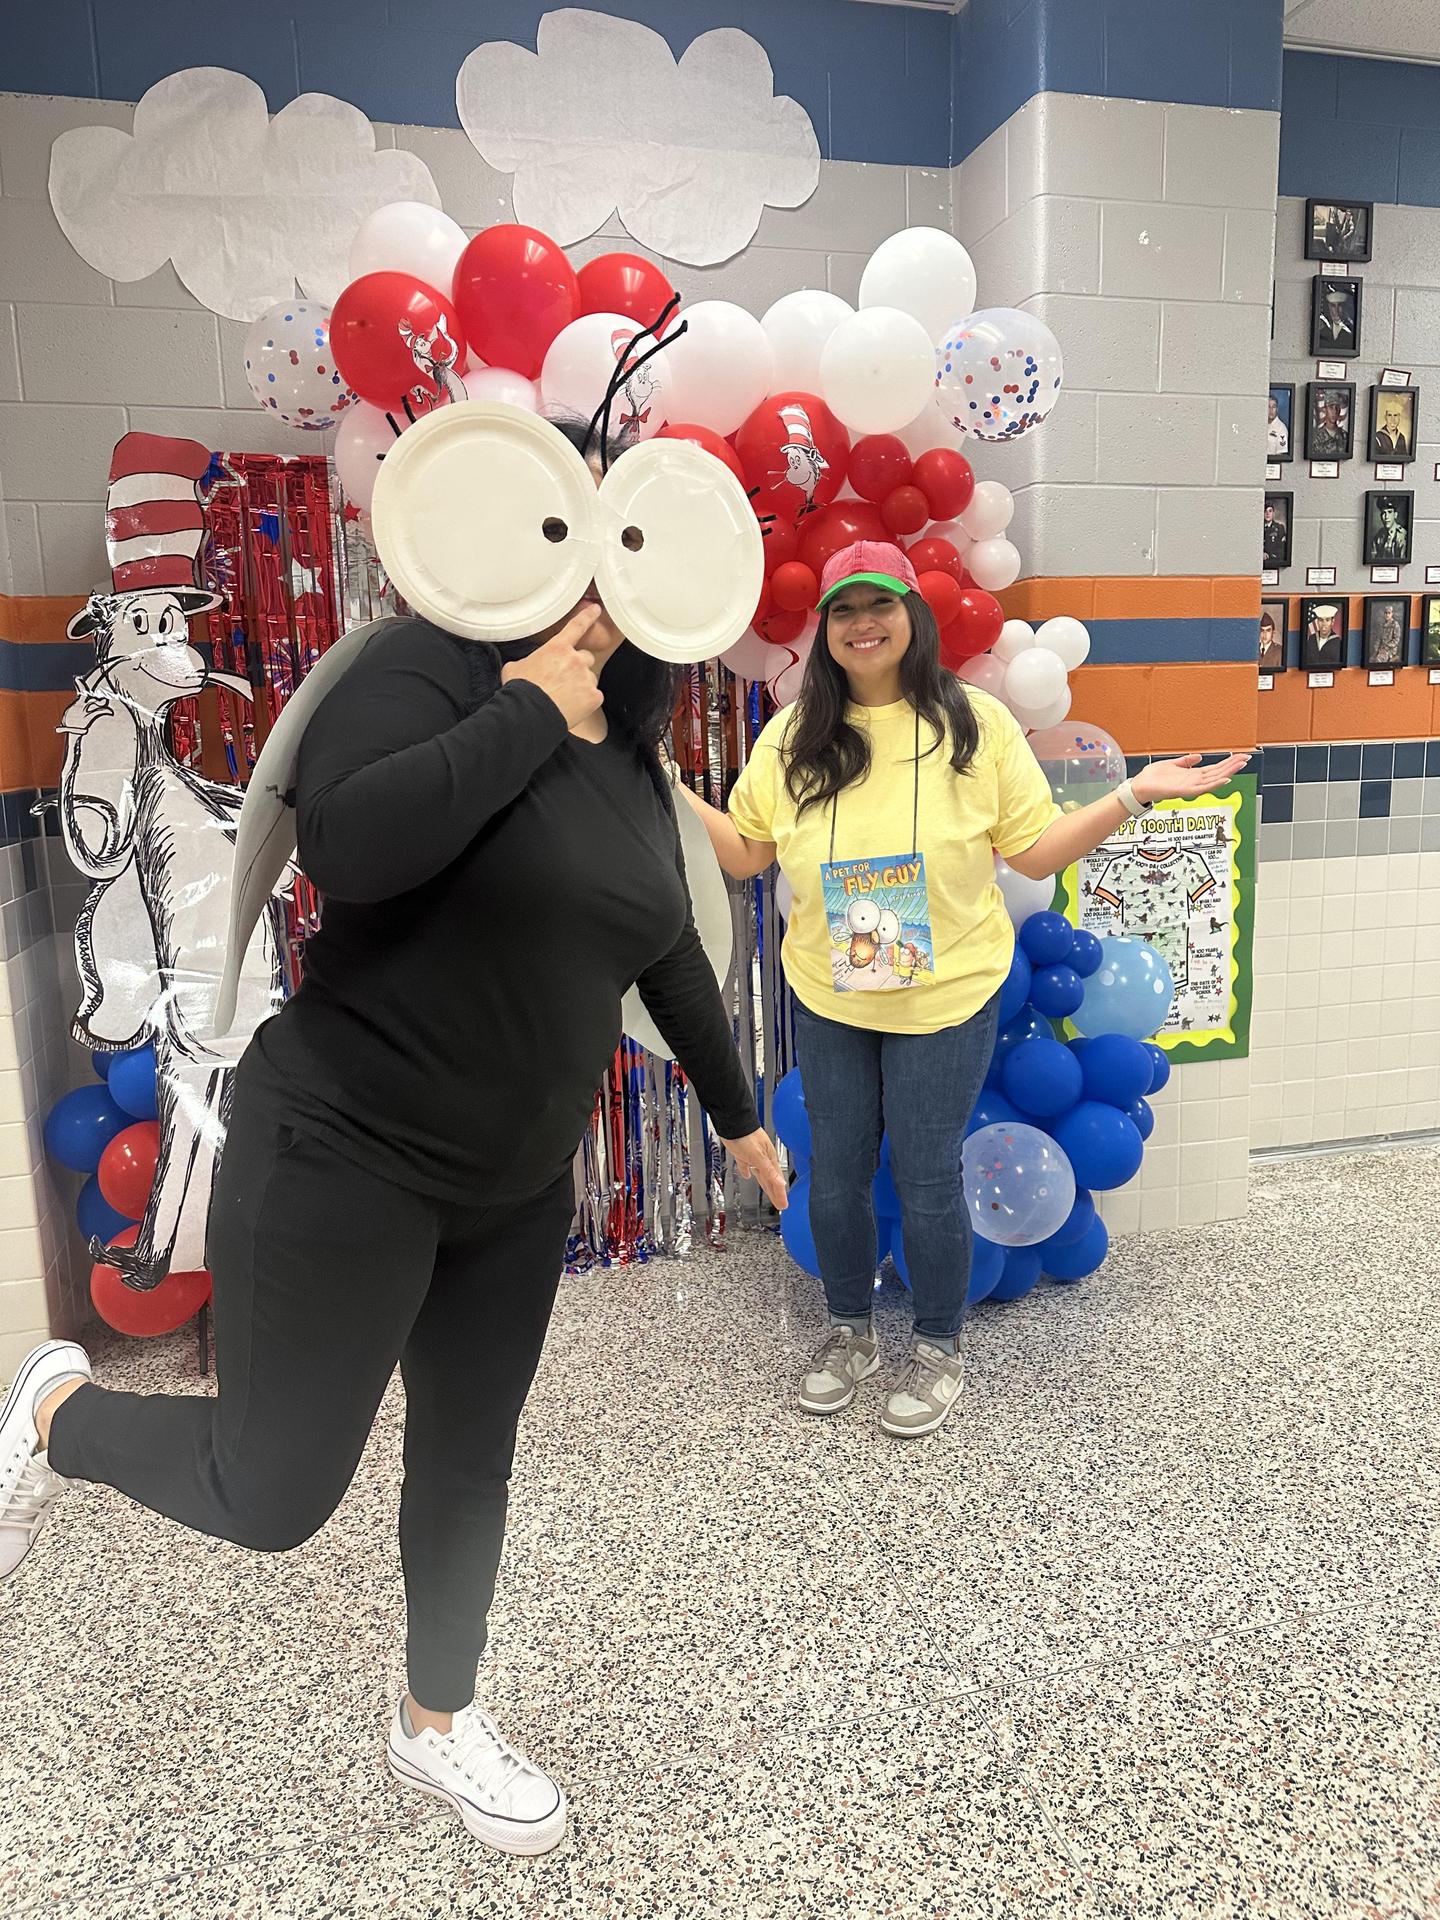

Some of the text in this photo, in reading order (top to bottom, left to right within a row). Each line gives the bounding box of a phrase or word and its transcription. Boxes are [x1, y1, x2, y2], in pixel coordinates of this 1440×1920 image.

[1141, 818, 1183, 834] 100TH
[1187, 815, 1219, 831] DAY!
[1160, 853, 1184, 869] COLLECTION
[825, 862, 870, 880] A PET FOR
[843, 870, 879, 896] FLY
[882, 860, 922, 887] GUY
